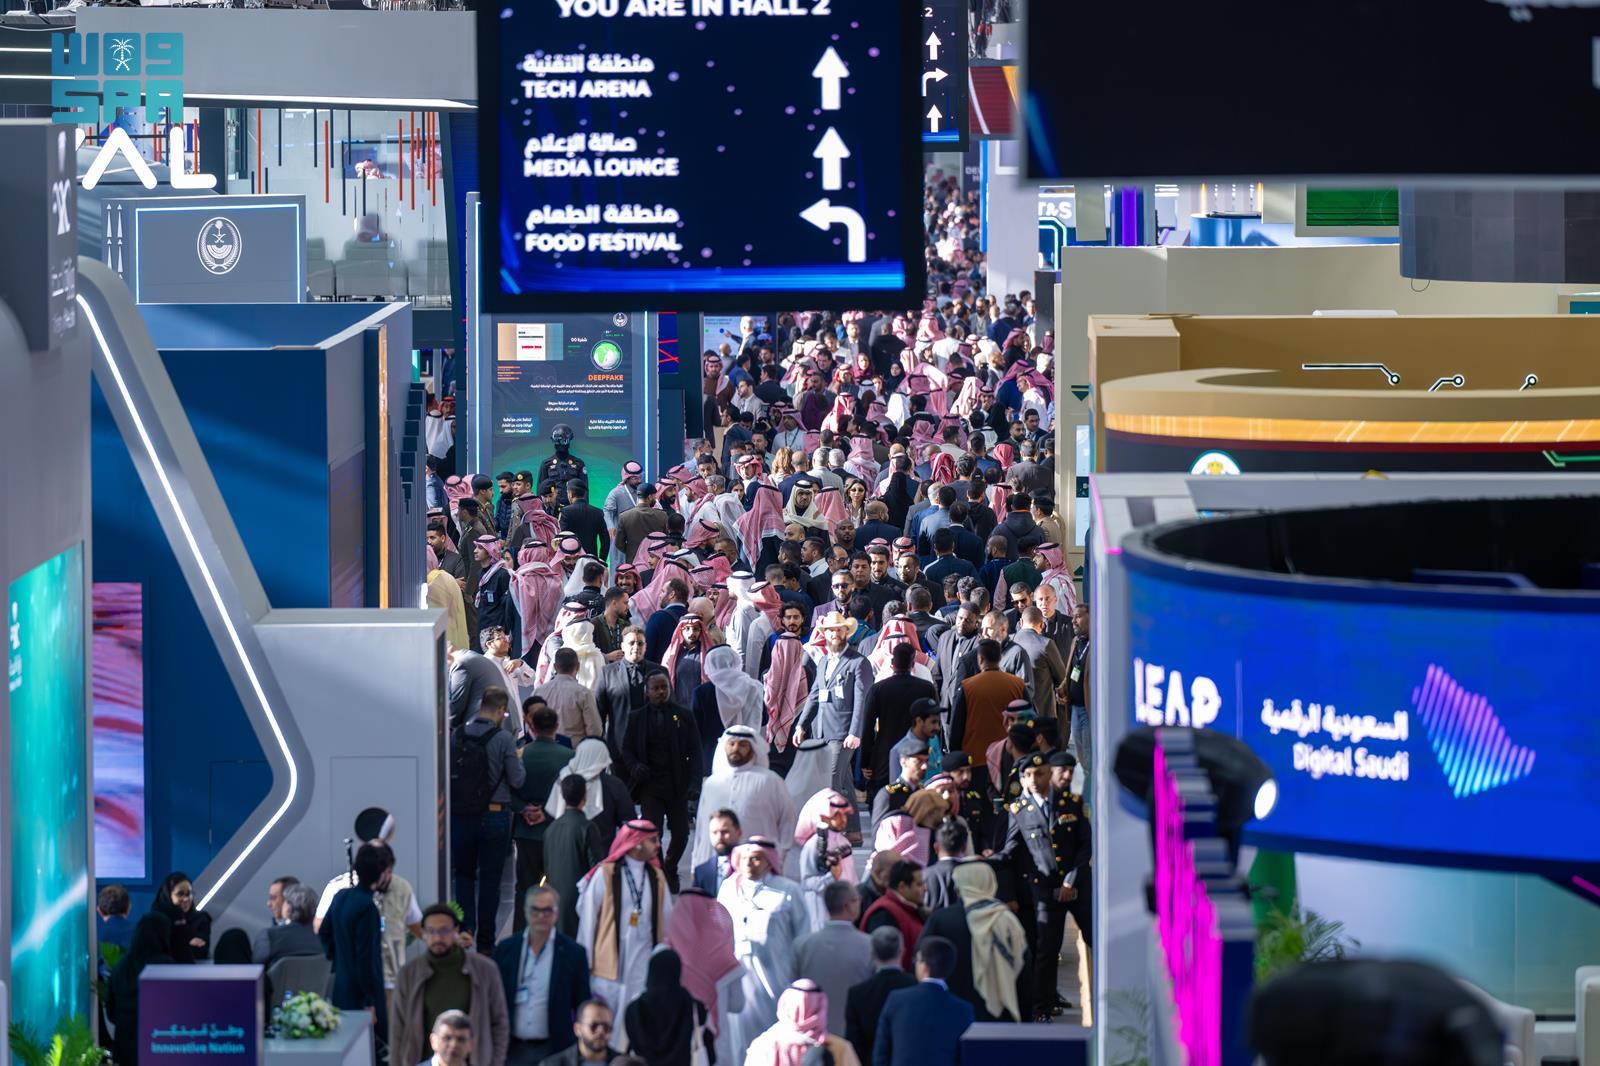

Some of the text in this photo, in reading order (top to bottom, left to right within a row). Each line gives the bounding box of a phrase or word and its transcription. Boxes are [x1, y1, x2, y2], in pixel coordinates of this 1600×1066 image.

[557, 0, 831, 17] YOU ARE IN HALL 2
[924, 7, 934, 18] 2
[522, 54, 655, 78] منطقة التقنية
[520, 80, 653, 98] TECH ARENA
[524, 132, 637, 159] صالة الإعلام
[524, 157, 679, 177] MEDIA LOUNGE
[525, 203, 680, 232] منطقة الطعام
[525, 232, 683, 252] FOOD FESTIVAL
[588, 374, 624, 382] DEEPFAKE
[1134, 656, 1222, 729] LEAP
[1261, 699, 1409, 743] السعودية الرقمية
[1293, 741, 1409, 781] Digital Saudi
[151, 1042, 245, 1054] Innovative Nation
